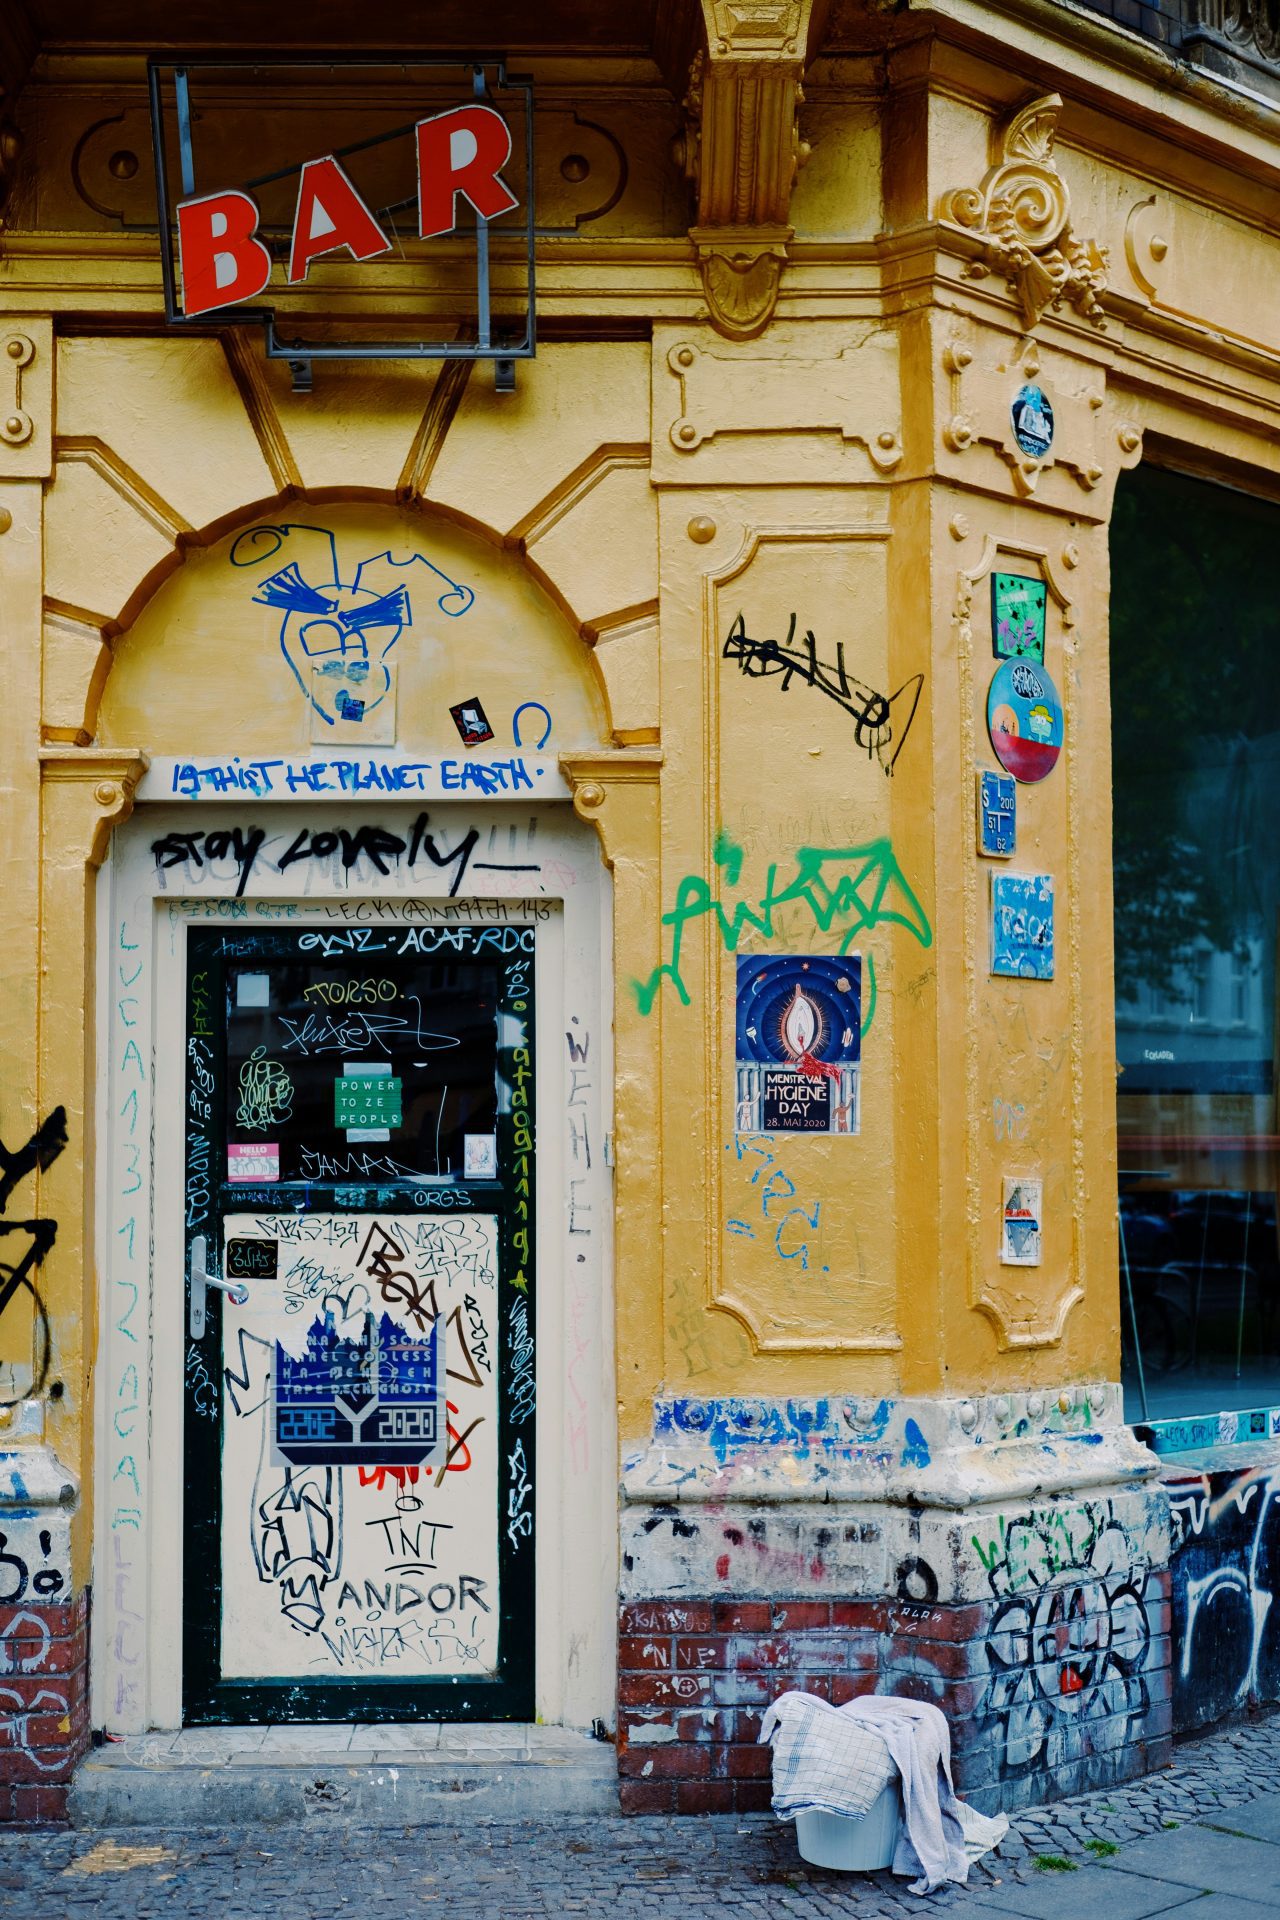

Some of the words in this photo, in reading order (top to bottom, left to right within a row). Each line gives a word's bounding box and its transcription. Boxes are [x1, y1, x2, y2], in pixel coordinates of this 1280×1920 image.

[176, 103, 520, 318] BAR
[1000, 796, 1015, 810] 200
[341, 1081, 395, 1091] POWER
[766, 1085, 827, 1101] HYGIENE
[341, 1098, 357, 1107] TO
[365, 1098, 384, 1107] ZE
[778, 1102, 811, 1117] DAY
[766, 1117, 781, 1127] 28.
[783, 1117, 801, 1127] MAI
[803, 1118, 826, 1128] 2020
[239, 1146, 268, 1155] HELLO
[349, 1351, 431, 1362] GODLESS
[379, 1409, 434, 1439] 2020
[365, 1516, 453, 1560] TNT
[338, 1575, 492, 1615] ANDOR
